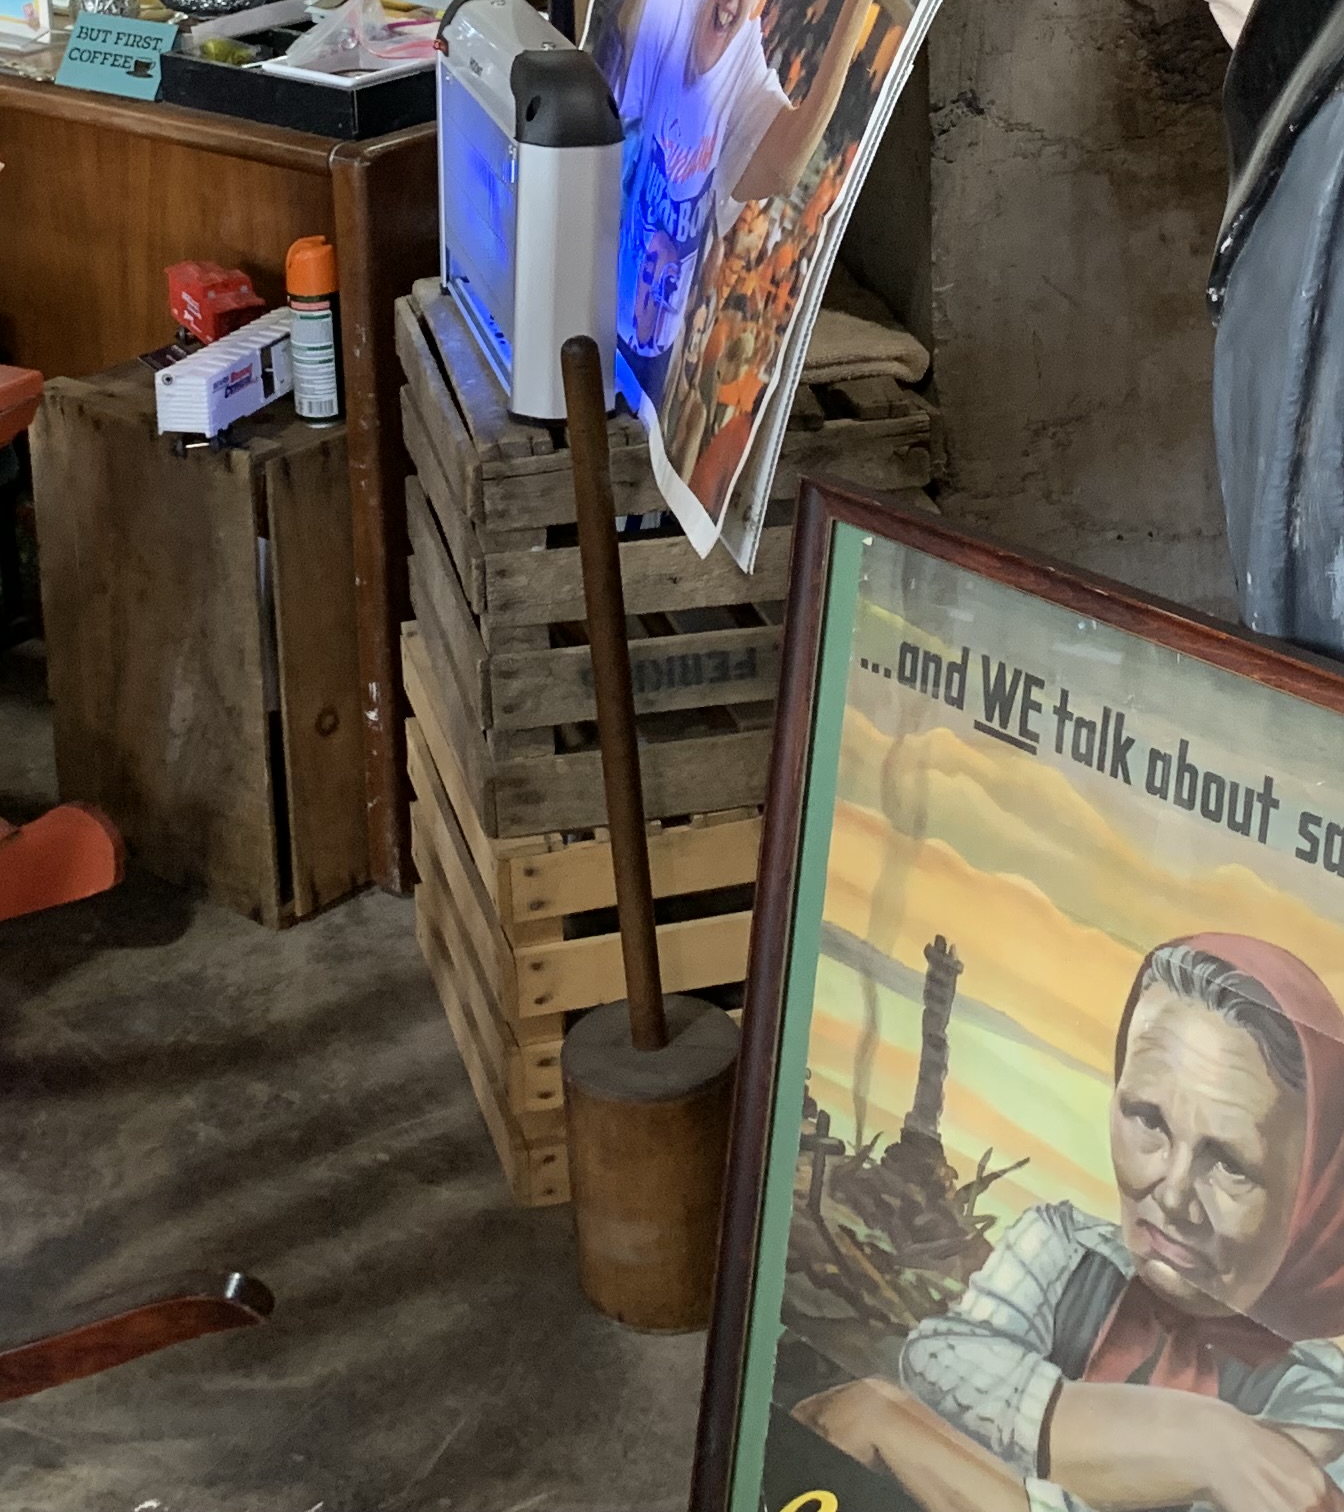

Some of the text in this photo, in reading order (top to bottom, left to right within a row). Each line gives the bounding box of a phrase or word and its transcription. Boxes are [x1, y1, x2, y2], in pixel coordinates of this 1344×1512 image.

[76, 26, 163, 52] BUT FIRST,
[68, 47, 133, 69] COFFEE
[860, 641, 970, 710] ...and
[981, 653, 1045, 744] WE
[1053, 688, 1135, 785] talk
[1145, 738, 1280, 844] about
